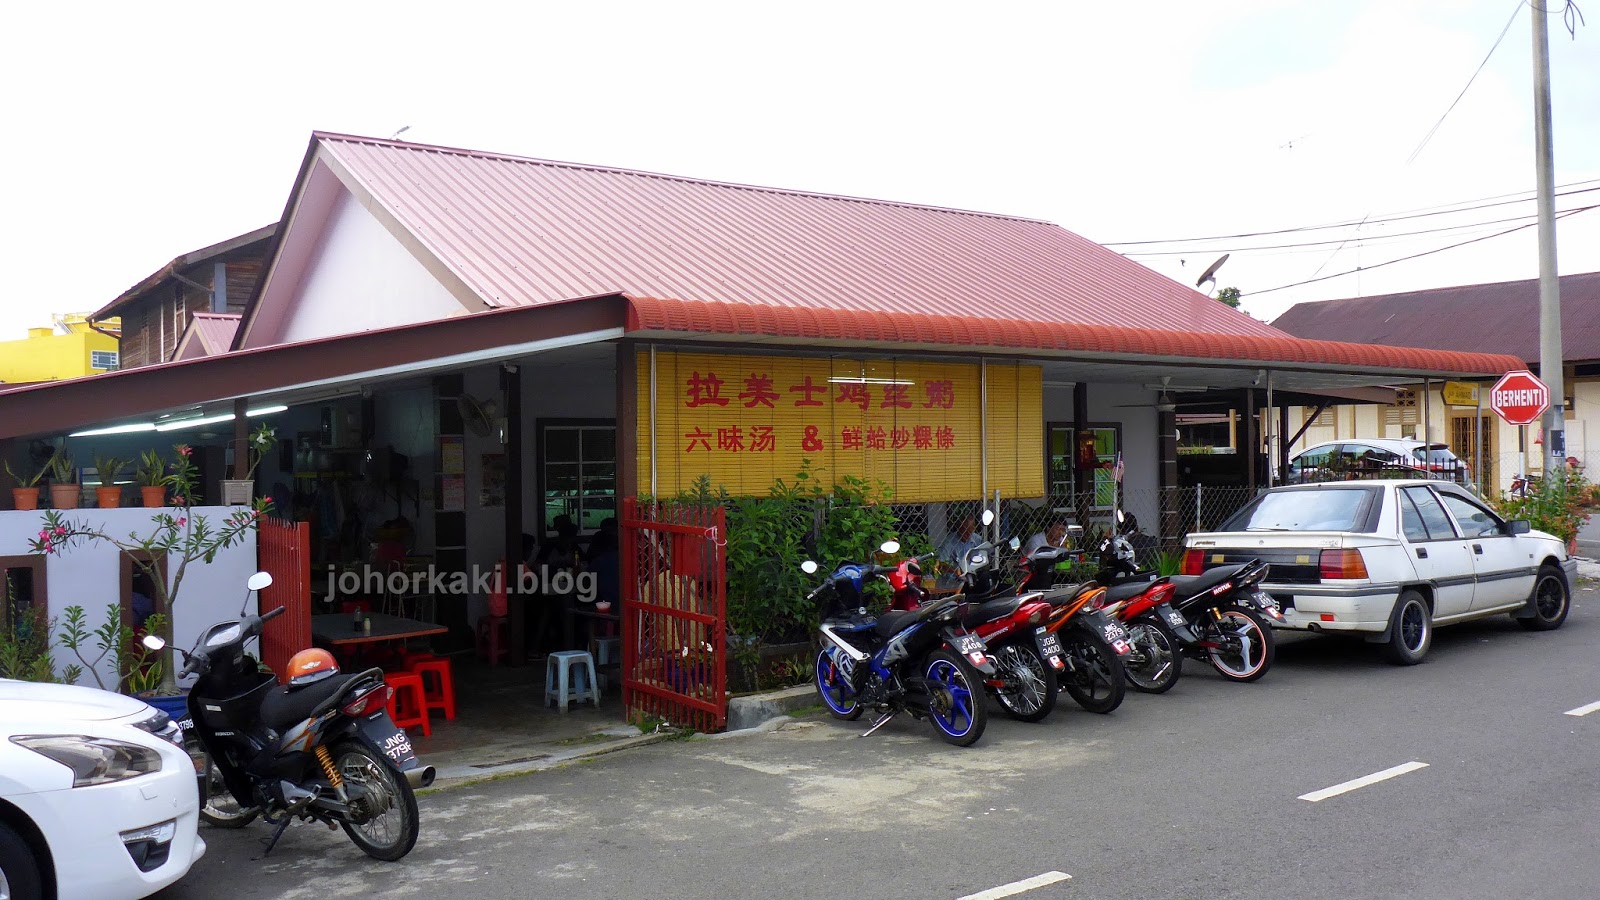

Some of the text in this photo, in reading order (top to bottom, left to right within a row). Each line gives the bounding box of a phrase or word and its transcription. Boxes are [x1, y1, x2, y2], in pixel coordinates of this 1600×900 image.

[685, 371, 954, 411] 拉美士鸡丝粥
[1496, 389, 1542, 407] BERHENTI
[685, 424, 776, 453] 六味汤
[801, 424, 824, 452] &
[1213, 582, 1232, 596] MOTUL
[1104, 623, 1117, 634] JMG
[1104, 627, 1124, 641] 2379
[1042, 636, 1056, 647] JGB
[1042, 644, 1061, 656] 3400
[384, 733, 405, 749] JNG
